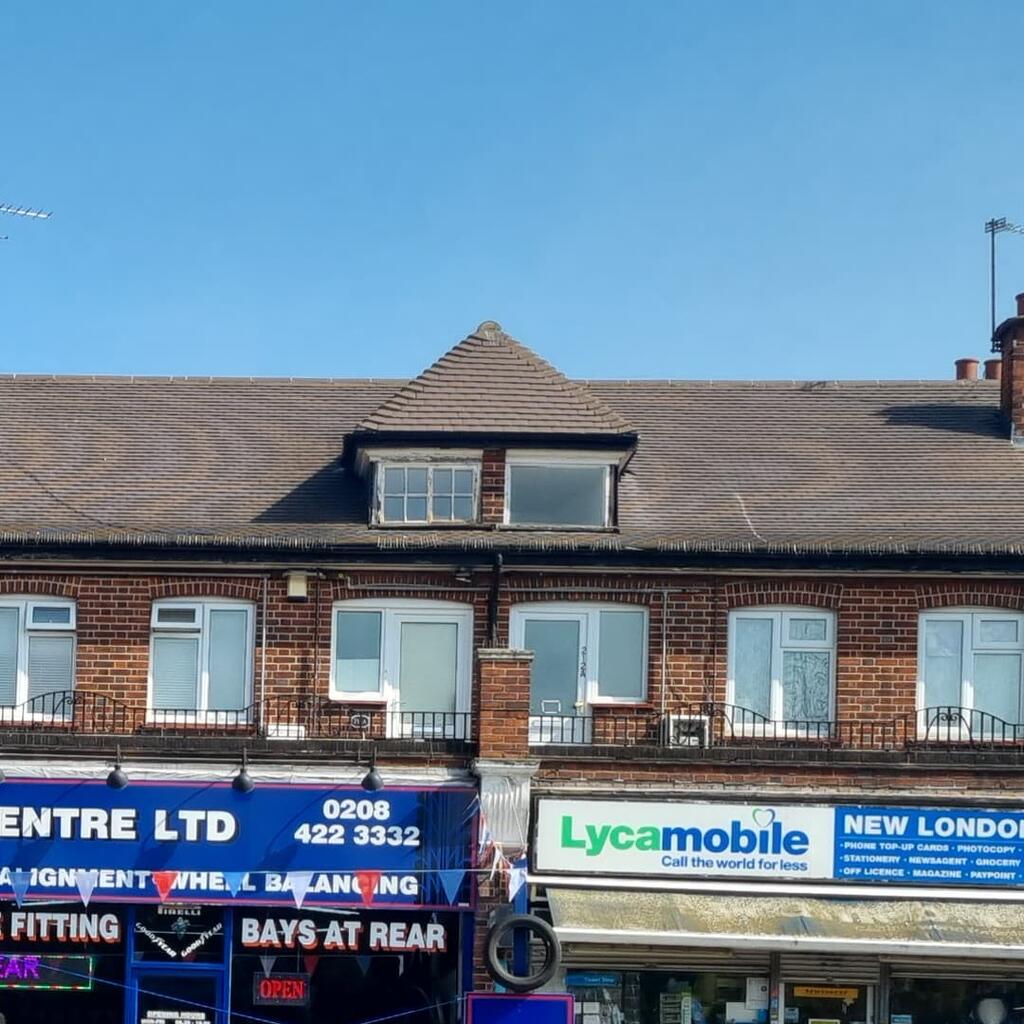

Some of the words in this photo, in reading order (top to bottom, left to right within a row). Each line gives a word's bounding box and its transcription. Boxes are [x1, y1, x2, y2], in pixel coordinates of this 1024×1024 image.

[322, 799, 391, 821] 0208
[154, 810, 237, 842] LTD
[294, 823, 345, 845] 422
[353, 825, 421, 847] 3332
[561, 815, 810, 857] Lycamobile
[844, 814, 909, 836] NEW
[844, 842, 877, 850] PHONE
[880, 842, 914, 851] TOP-UP
[917, 844, 949, 852] CARDS
[957, 845, 1016, 853] PHOTOCOPY
[661, 855, 689, 868] Call
[691, 857, 714, 869] the
[715, 858, 755, 870] world
[757, 858, 778, 871] for
[779, 859, 808, 872] less
[844, 855, 900, 864] STATIONERY
[909, 857, 968, 866] NEWSAGENT
[976, 859, 1021, 867] GROCERY
[844, 868, 861, 876] OFF
[864, 869, 905, 877] LICENCE
[913, 870, 962, 878] MAGAZINE
[970, 871, 1016, 880] PAYPOINT
[10, 911, 121, 942] FITTING
[241, 918, 317, 949] BAYS
[323, 920, 362, 949] AT
[369, 921, 447, 951] REAR
[259, 977, 305, 999] OPEN
